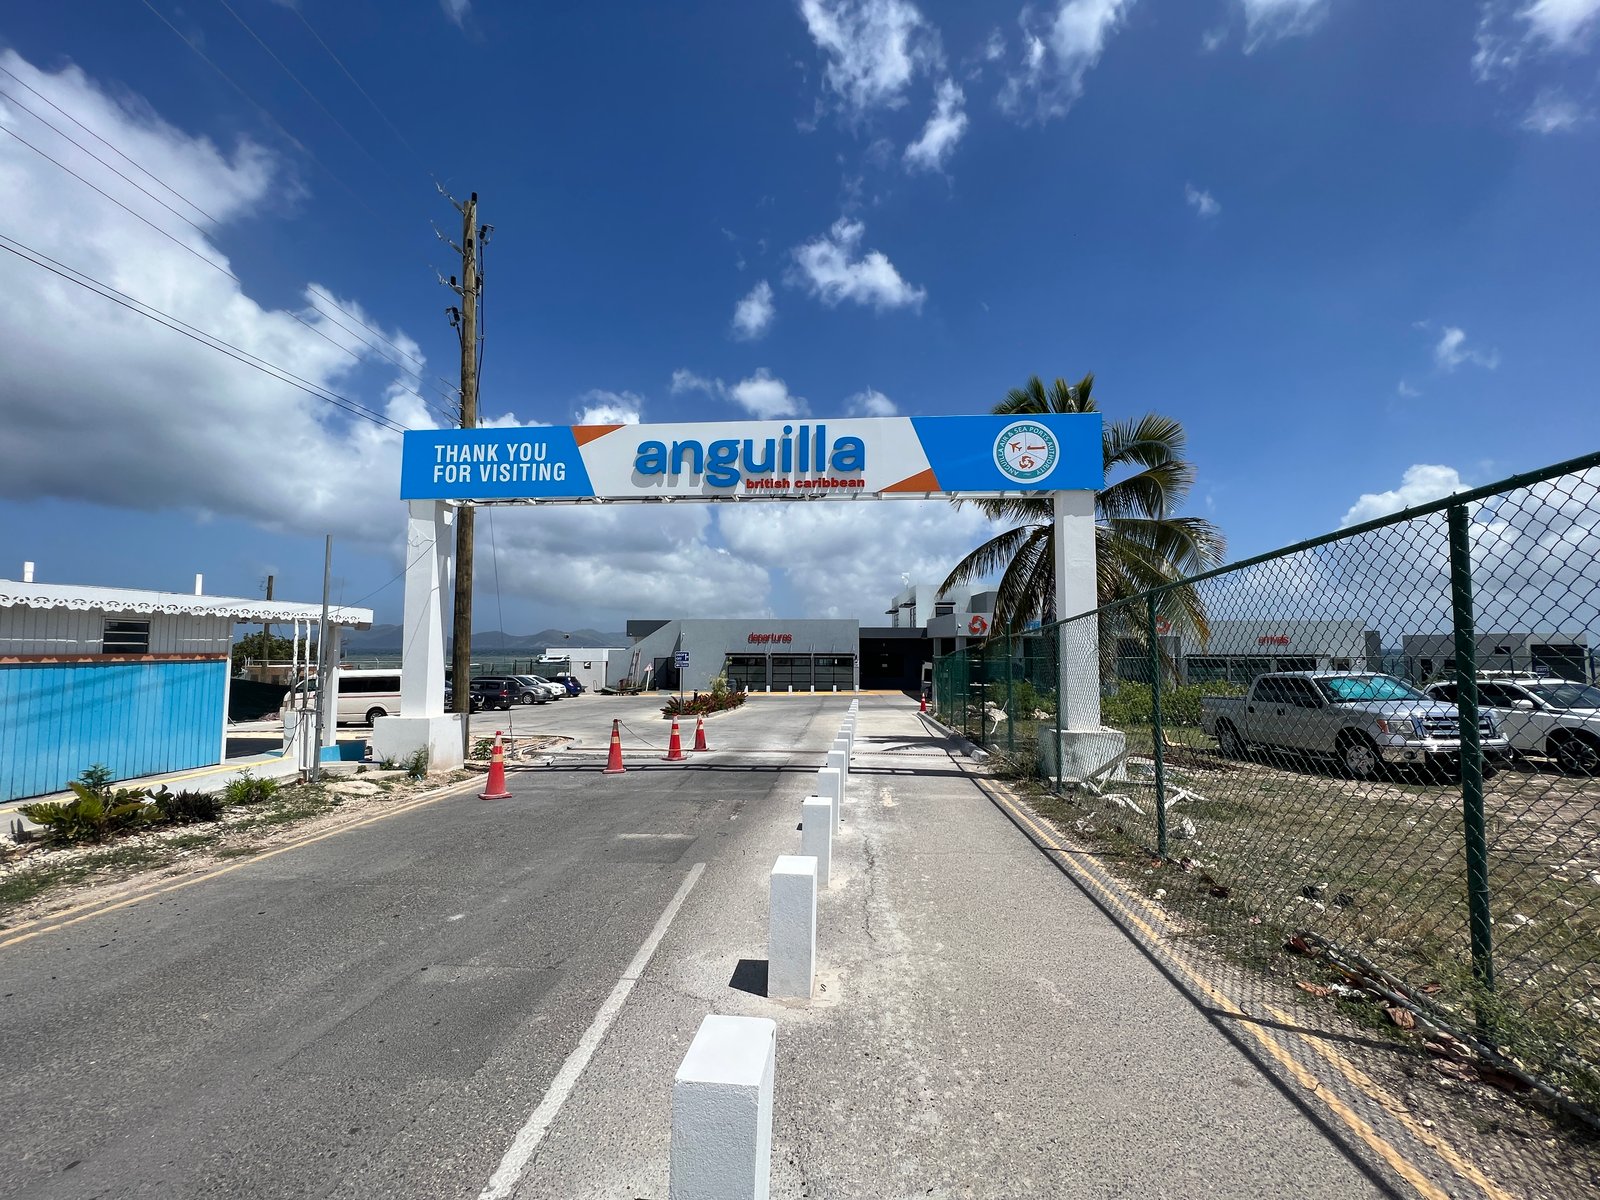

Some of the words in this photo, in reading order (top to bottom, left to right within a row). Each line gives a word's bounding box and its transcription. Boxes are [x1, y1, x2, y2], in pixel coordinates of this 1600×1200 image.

[1029, 426, 1049, 442] PORTS
[434, 444, 499, 462] THANK
[506, 442, 547, 461] YOU
[635, 424, 865, 487] anguilla
[433, 464, 472, 483] FOR
[479, 462, 566, 482] VISITING
[746, 478, 790, 489] british
[795, 477, 865, 488] caribbean
[748, 632, 792, 645] departures
